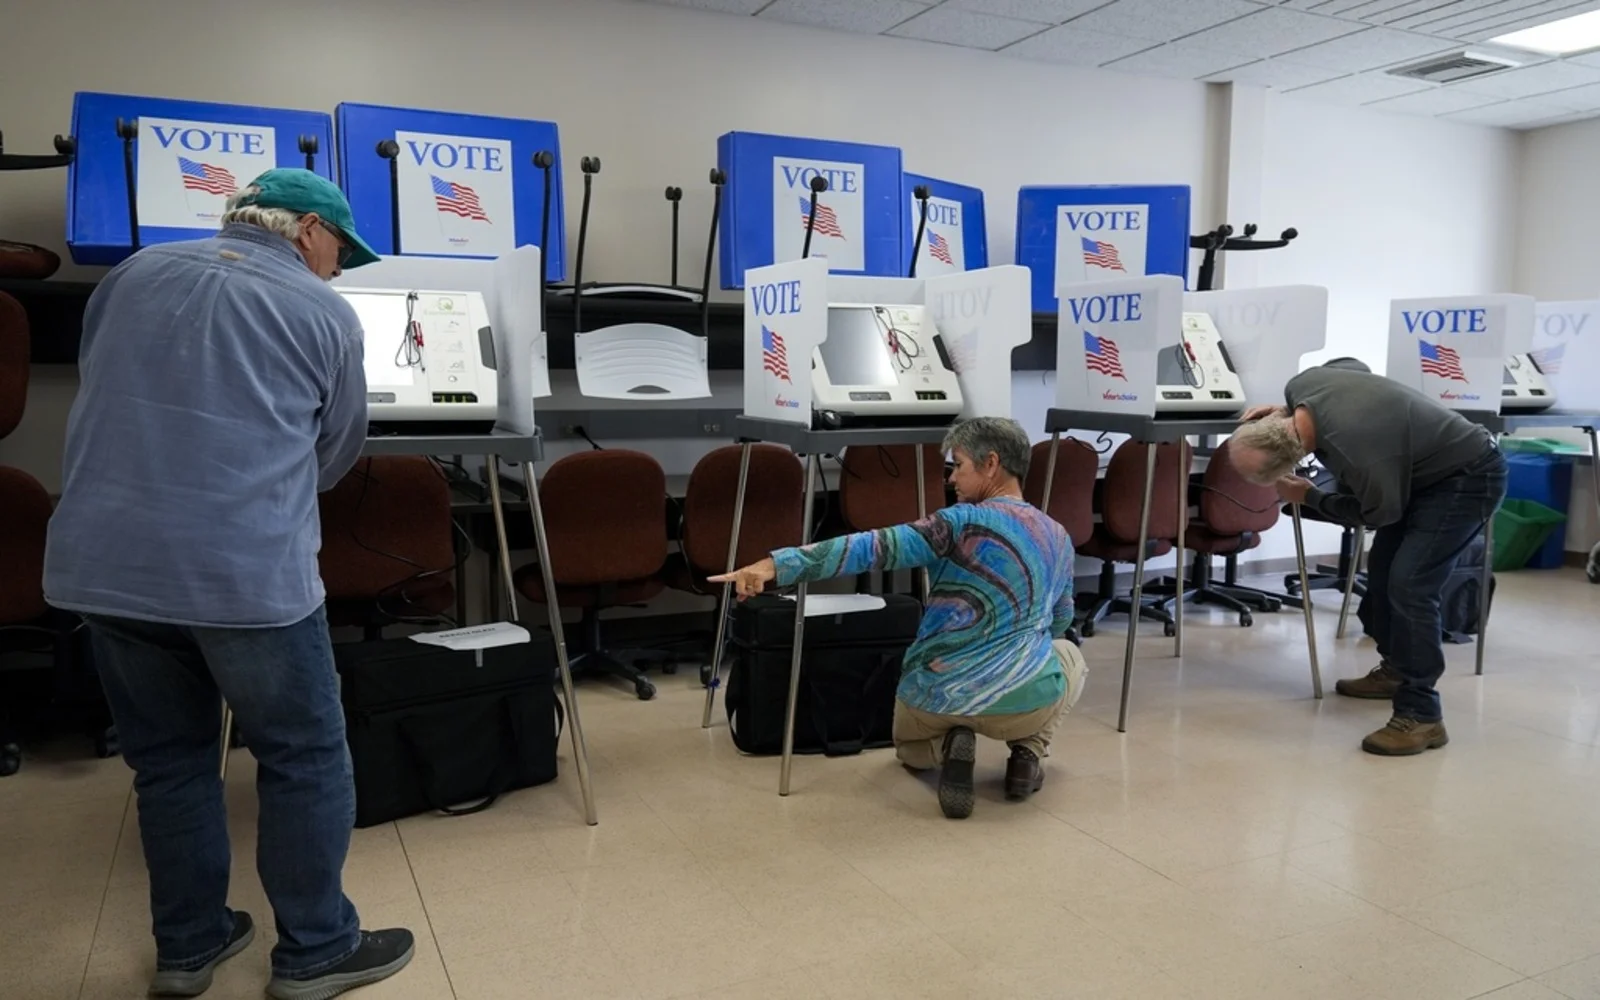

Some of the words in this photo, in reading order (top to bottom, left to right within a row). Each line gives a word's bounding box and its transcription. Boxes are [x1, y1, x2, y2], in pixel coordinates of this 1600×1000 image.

[150, 125, 265, 155] VOTE
[406, 140, 503, 172] VOTE
[781, 165, 857, 193] VOTE
[1065, 211, 1140, 231] VOTE
[751, 280, 801, 316] VOTE
[1069, 293, 1142, 324] VOTE
[1402, 308, 1487, 334] VOTE
